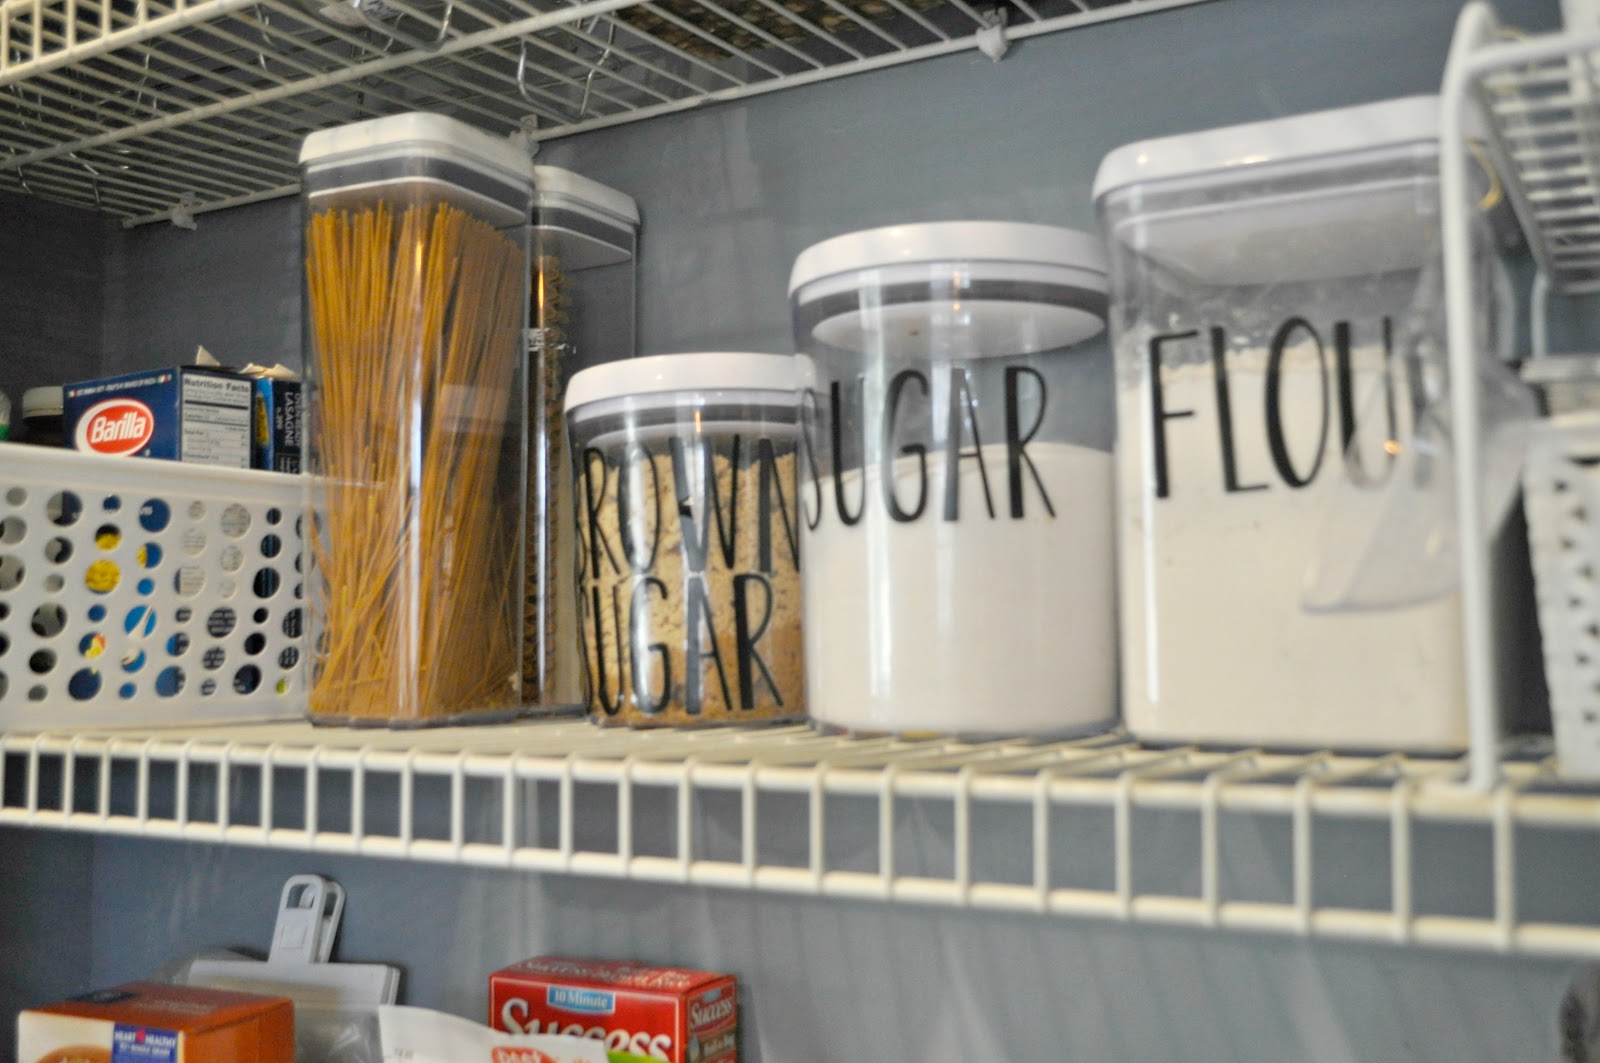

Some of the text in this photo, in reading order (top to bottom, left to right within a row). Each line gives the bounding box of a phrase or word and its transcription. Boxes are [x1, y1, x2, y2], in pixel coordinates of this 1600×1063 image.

[184, 377, 250, 393] Nutrition Facts
[90, 410, 148, 444] Barilla
[284, 391, 294, 447] LASAGNE
[799, 366, 1057, 532] SUGAR
[554, 989, 608, 1009] 10 Minute
